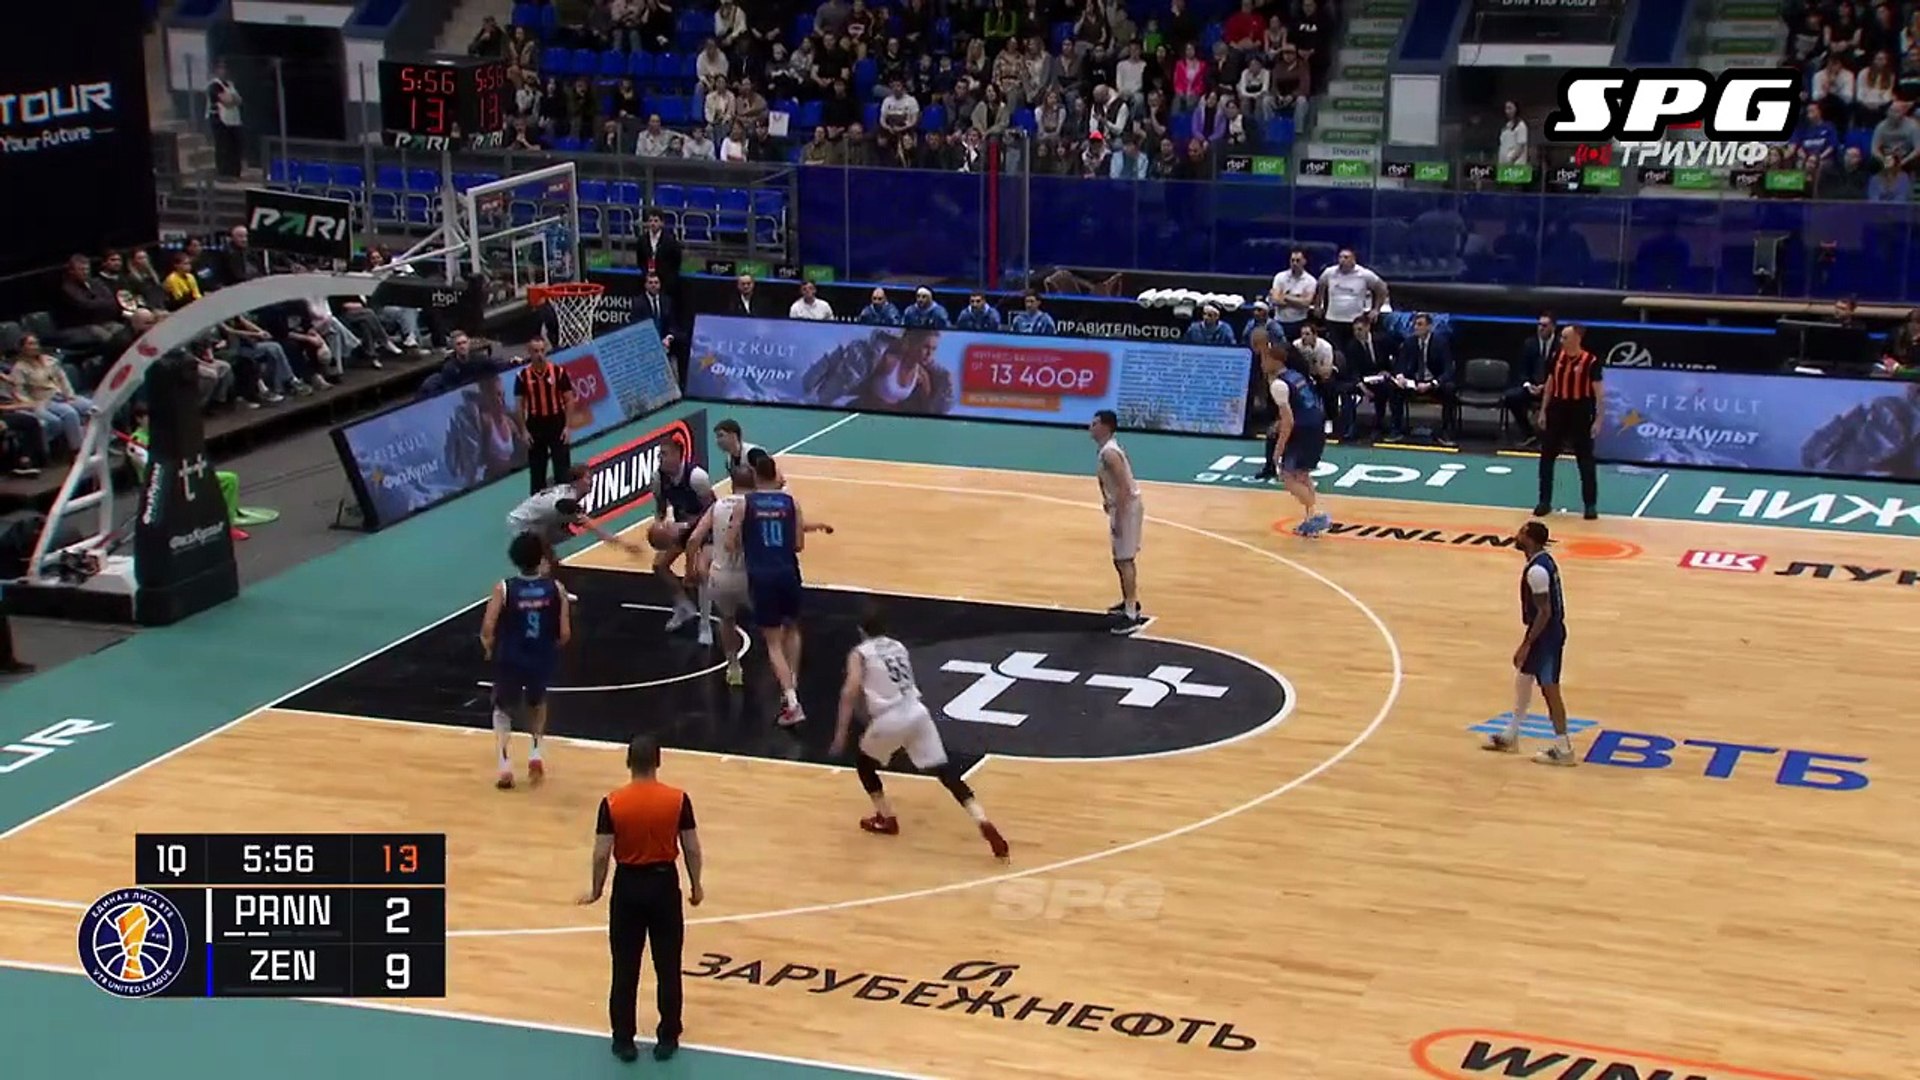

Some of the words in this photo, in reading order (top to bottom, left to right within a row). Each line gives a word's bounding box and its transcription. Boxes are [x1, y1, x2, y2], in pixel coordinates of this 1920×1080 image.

[402, 67, 455, 94] 5:56
[0, 82, 112, 125] TOUR
[411, 96, 444, 134] 13
[250, 207, 346, 241] PARI
[1057, 320, 1181, 339] ПРАВИТЕЛЬСТВО
[990, 363, 1013, 385] 13
[1644, 393, 1763, 416] FIZKULT
[1637, 421, 1760, 448] ФизКульт
[1584, 729, 1870, 791] ВТБ
[682, 952, 1258, 1052] ЗАРУБЕЖНЕФТЬ
